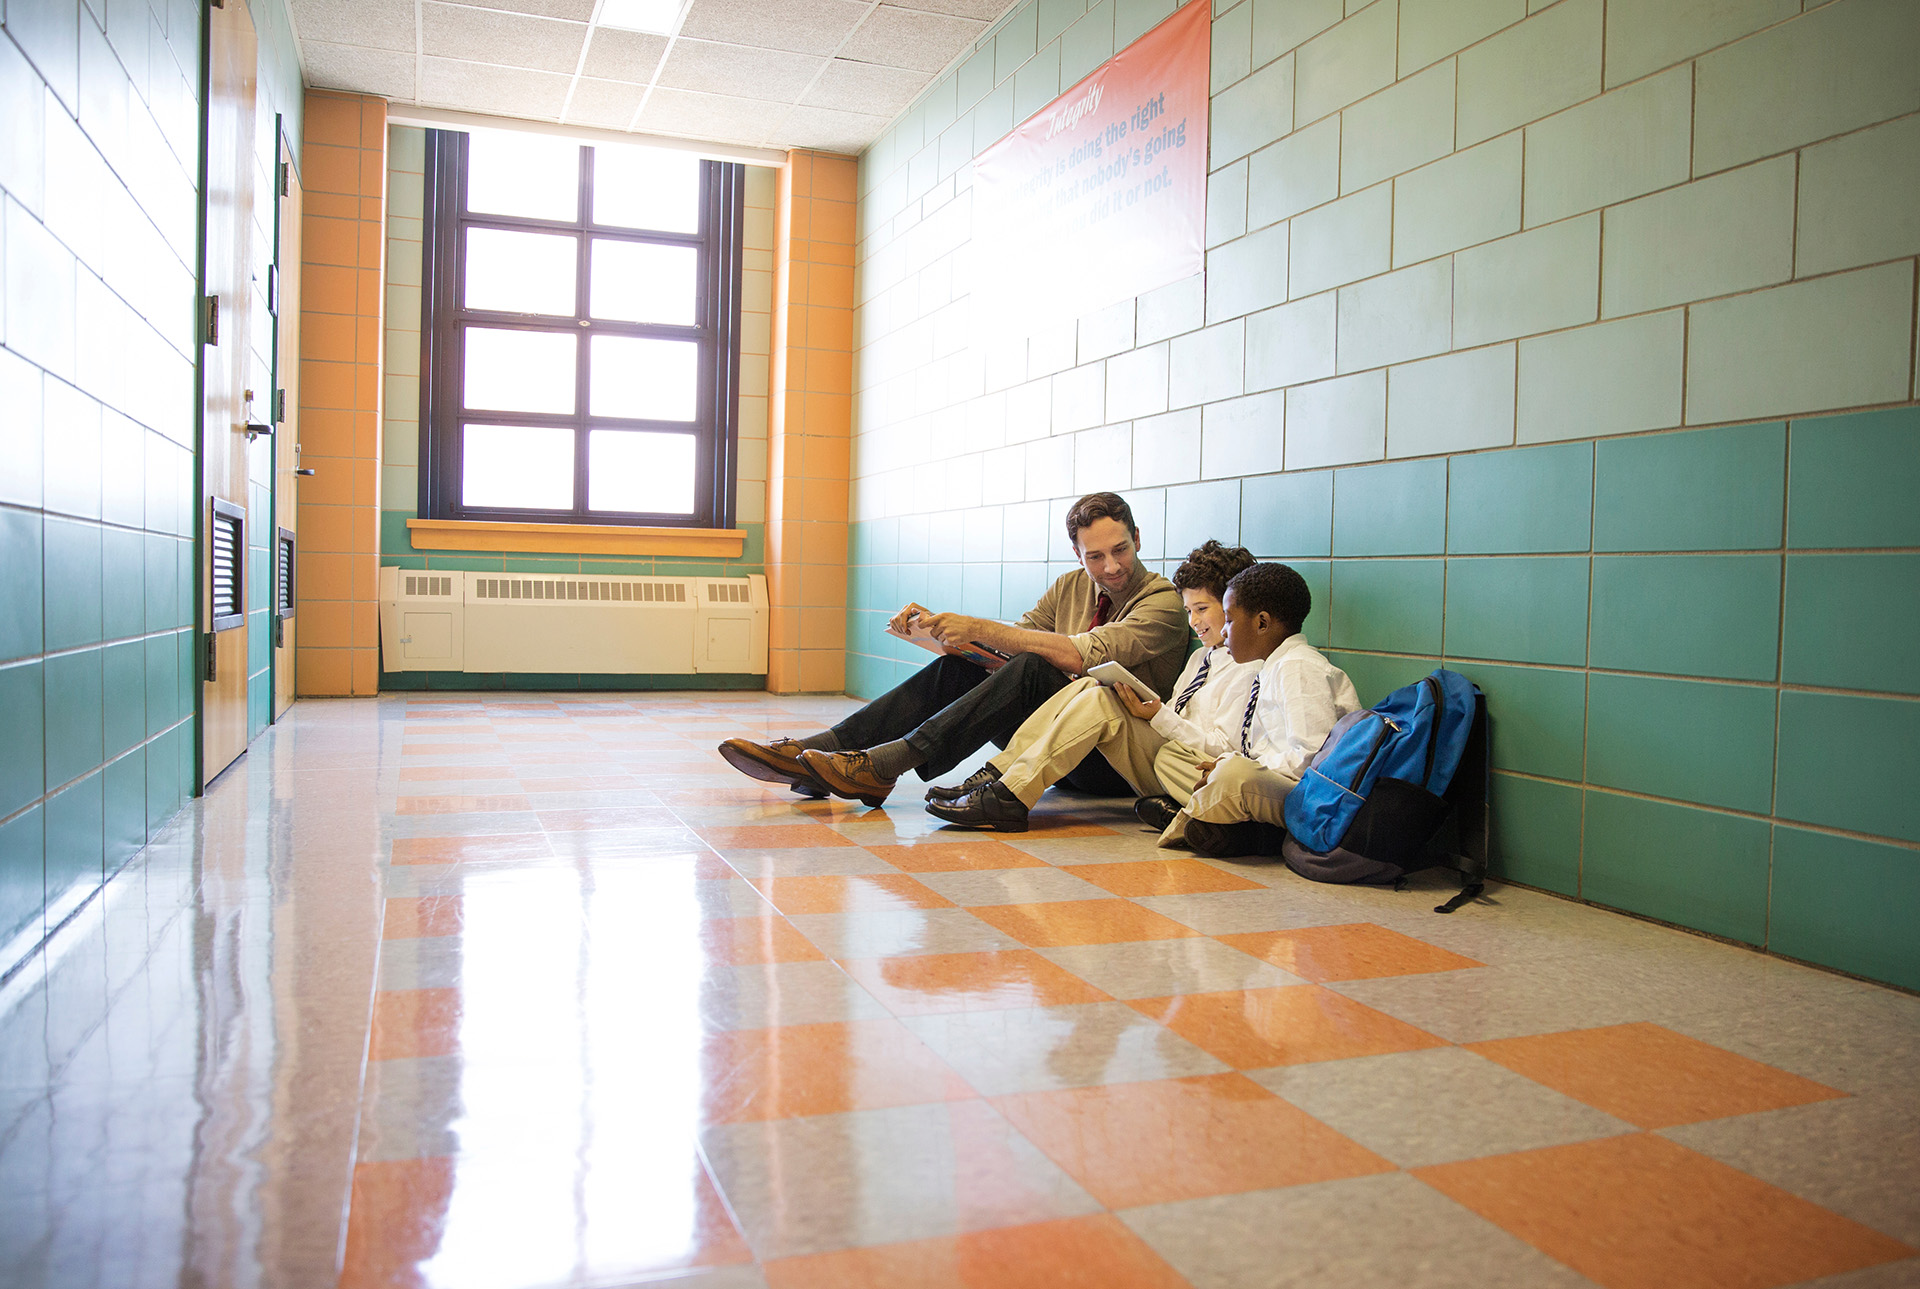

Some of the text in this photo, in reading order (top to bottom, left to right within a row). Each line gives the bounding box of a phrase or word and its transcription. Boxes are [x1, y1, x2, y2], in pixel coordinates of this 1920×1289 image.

[1045, 83, 1104, 141] Integrity
[1056, 155, 1066, 178] is
[1068, 131, 1103, 169] doing
[1105, 118, 1128, 148] the
[1131, 91, 1165, 133] right
[1056, 179, 1079, 209] that
[1082, 147, 1141, 197] nobody's
[1144, 117, 1187, 167] going
[1090, 195, 1110, 225] did
[1112, 189, 1124, 214] it
[1127, 181, 1142, 207] or
[1144, 165, 1173, 198] not.
